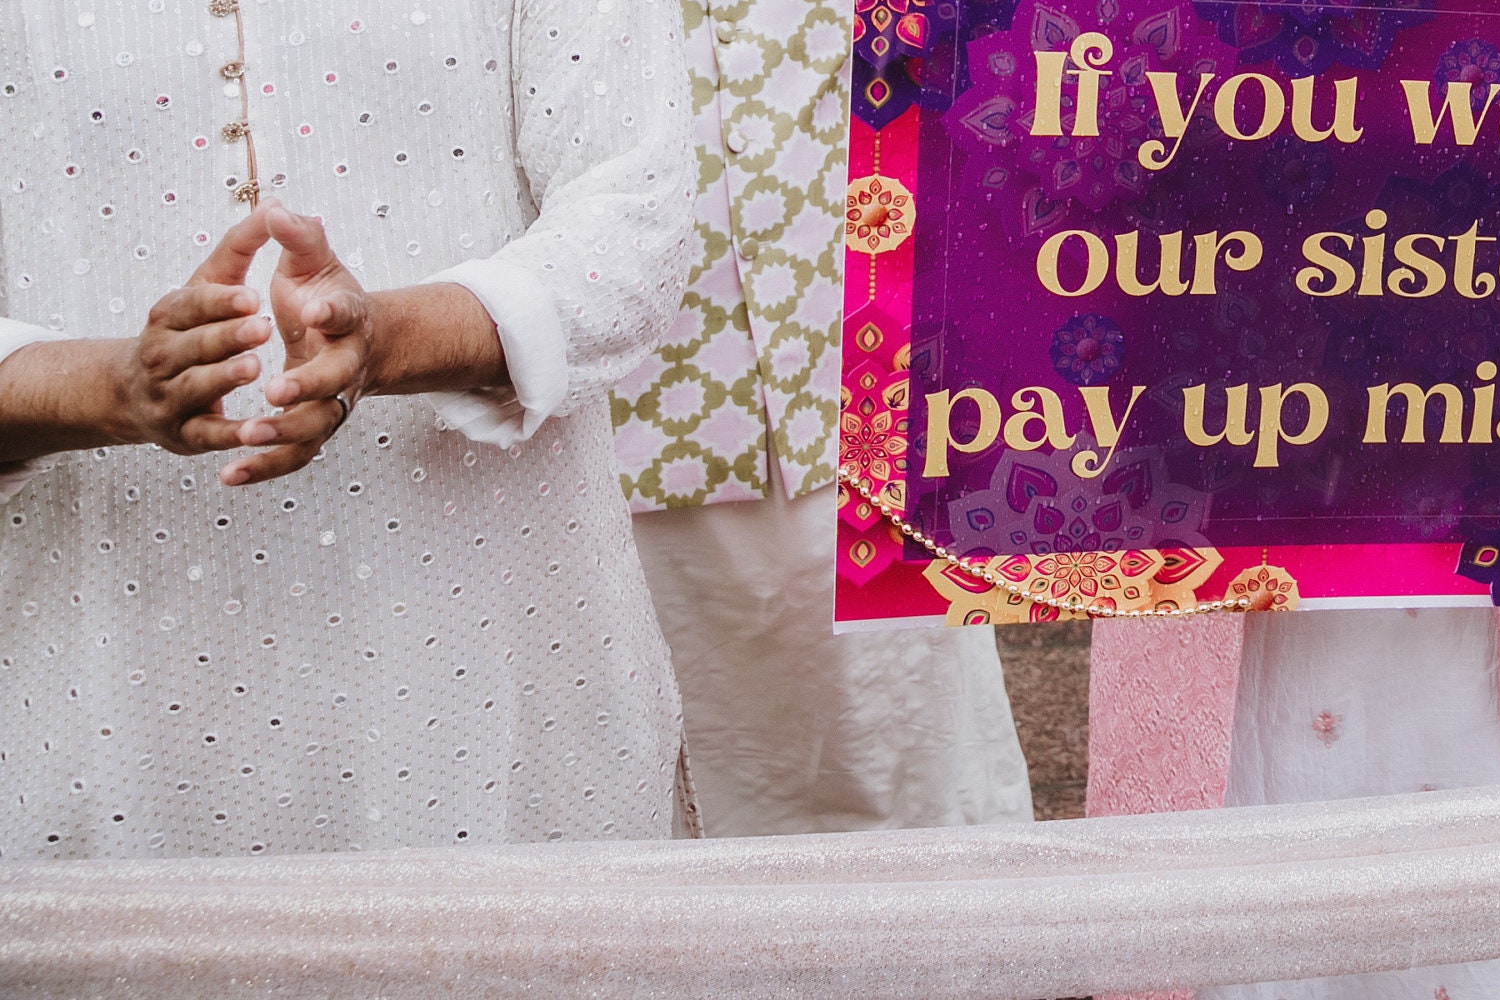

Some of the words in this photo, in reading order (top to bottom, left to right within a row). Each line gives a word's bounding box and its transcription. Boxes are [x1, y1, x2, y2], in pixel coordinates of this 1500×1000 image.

[1029, 32, 1113, 138] If
[1137, 71, 1364, 171] you
[1035, 230, 1264, 297] our
[922, 385, 1145, 480] pay
[1182, 382, 1330, 469] up
